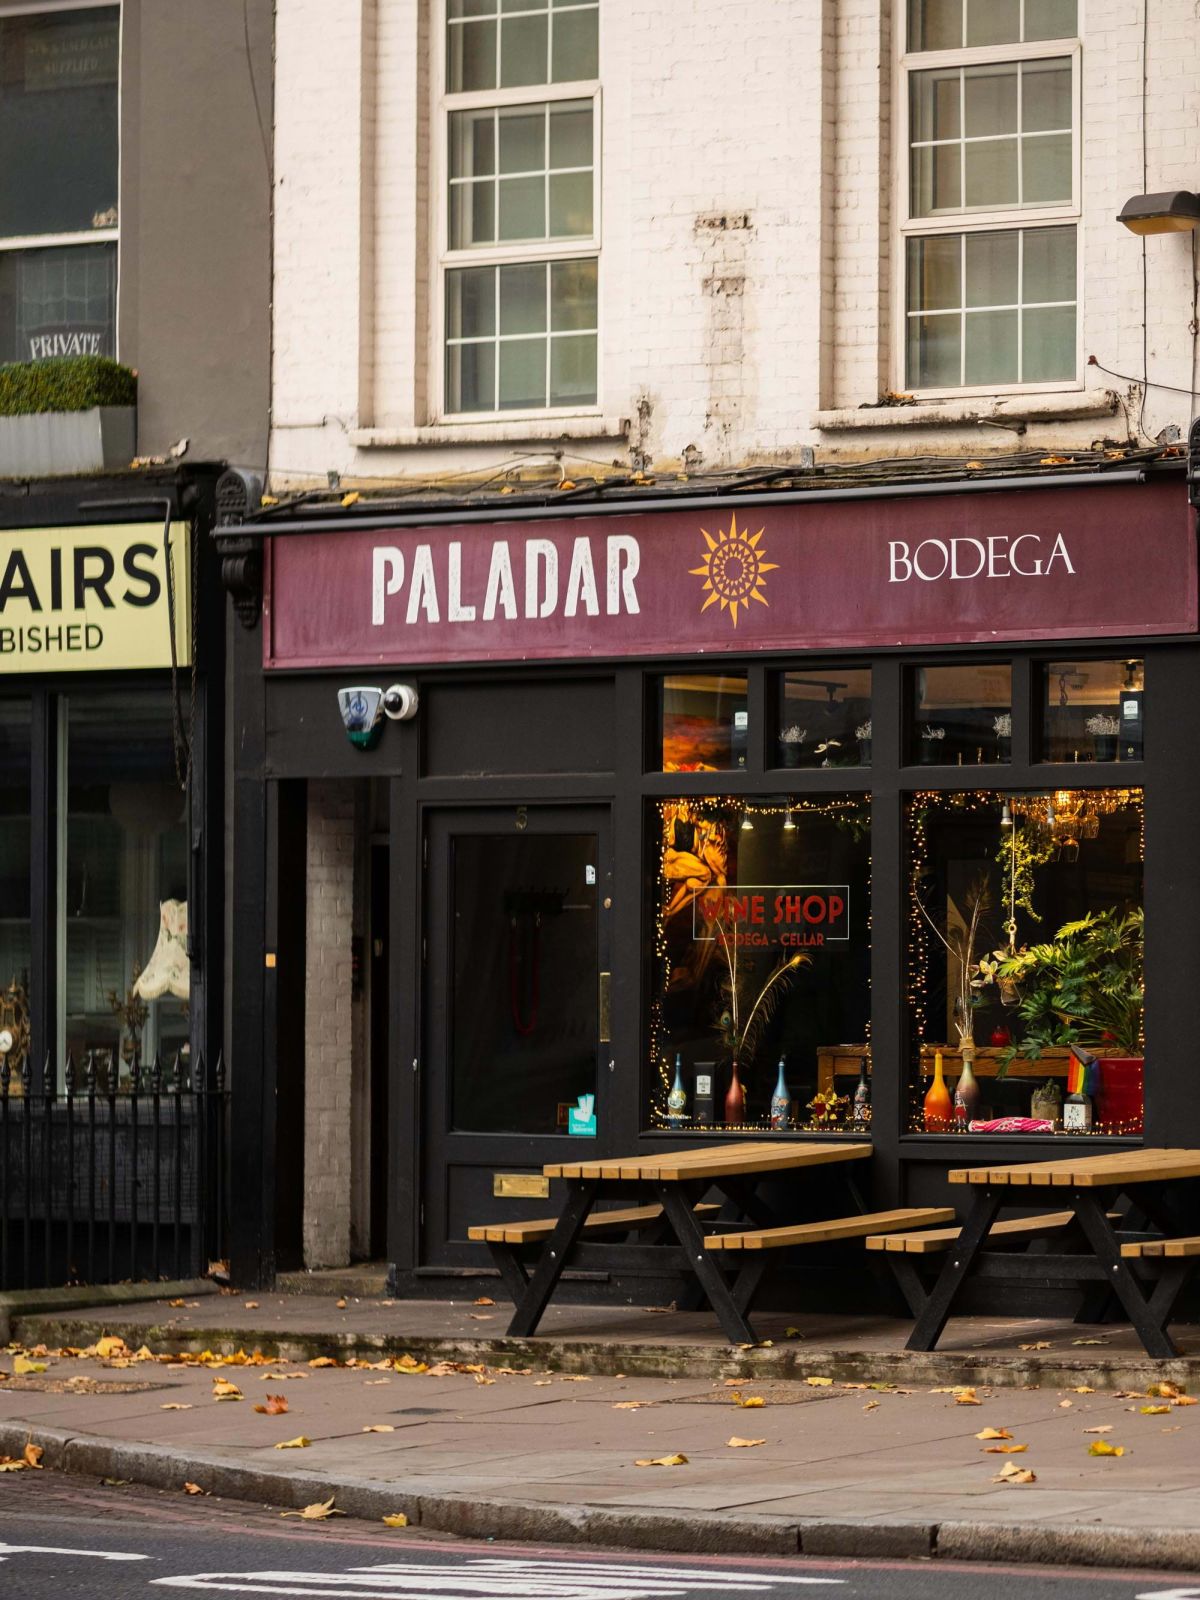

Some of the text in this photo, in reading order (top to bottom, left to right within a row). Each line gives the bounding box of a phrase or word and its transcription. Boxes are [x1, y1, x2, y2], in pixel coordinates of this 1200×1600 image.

[30, 332, 100, 359] PRIVATE
[888, 532, 1076, 582] BODEGA
[0, 543, 161, 613] AIRS
[372, 535, 641, 625] PALADAR
[0, 624, 104, 653] BISHED
[699, 895, 844, 925] WINE SHOP
[718, 932, 769, 947] BODEGA
[780, 932, 824, 947] CELLAR
